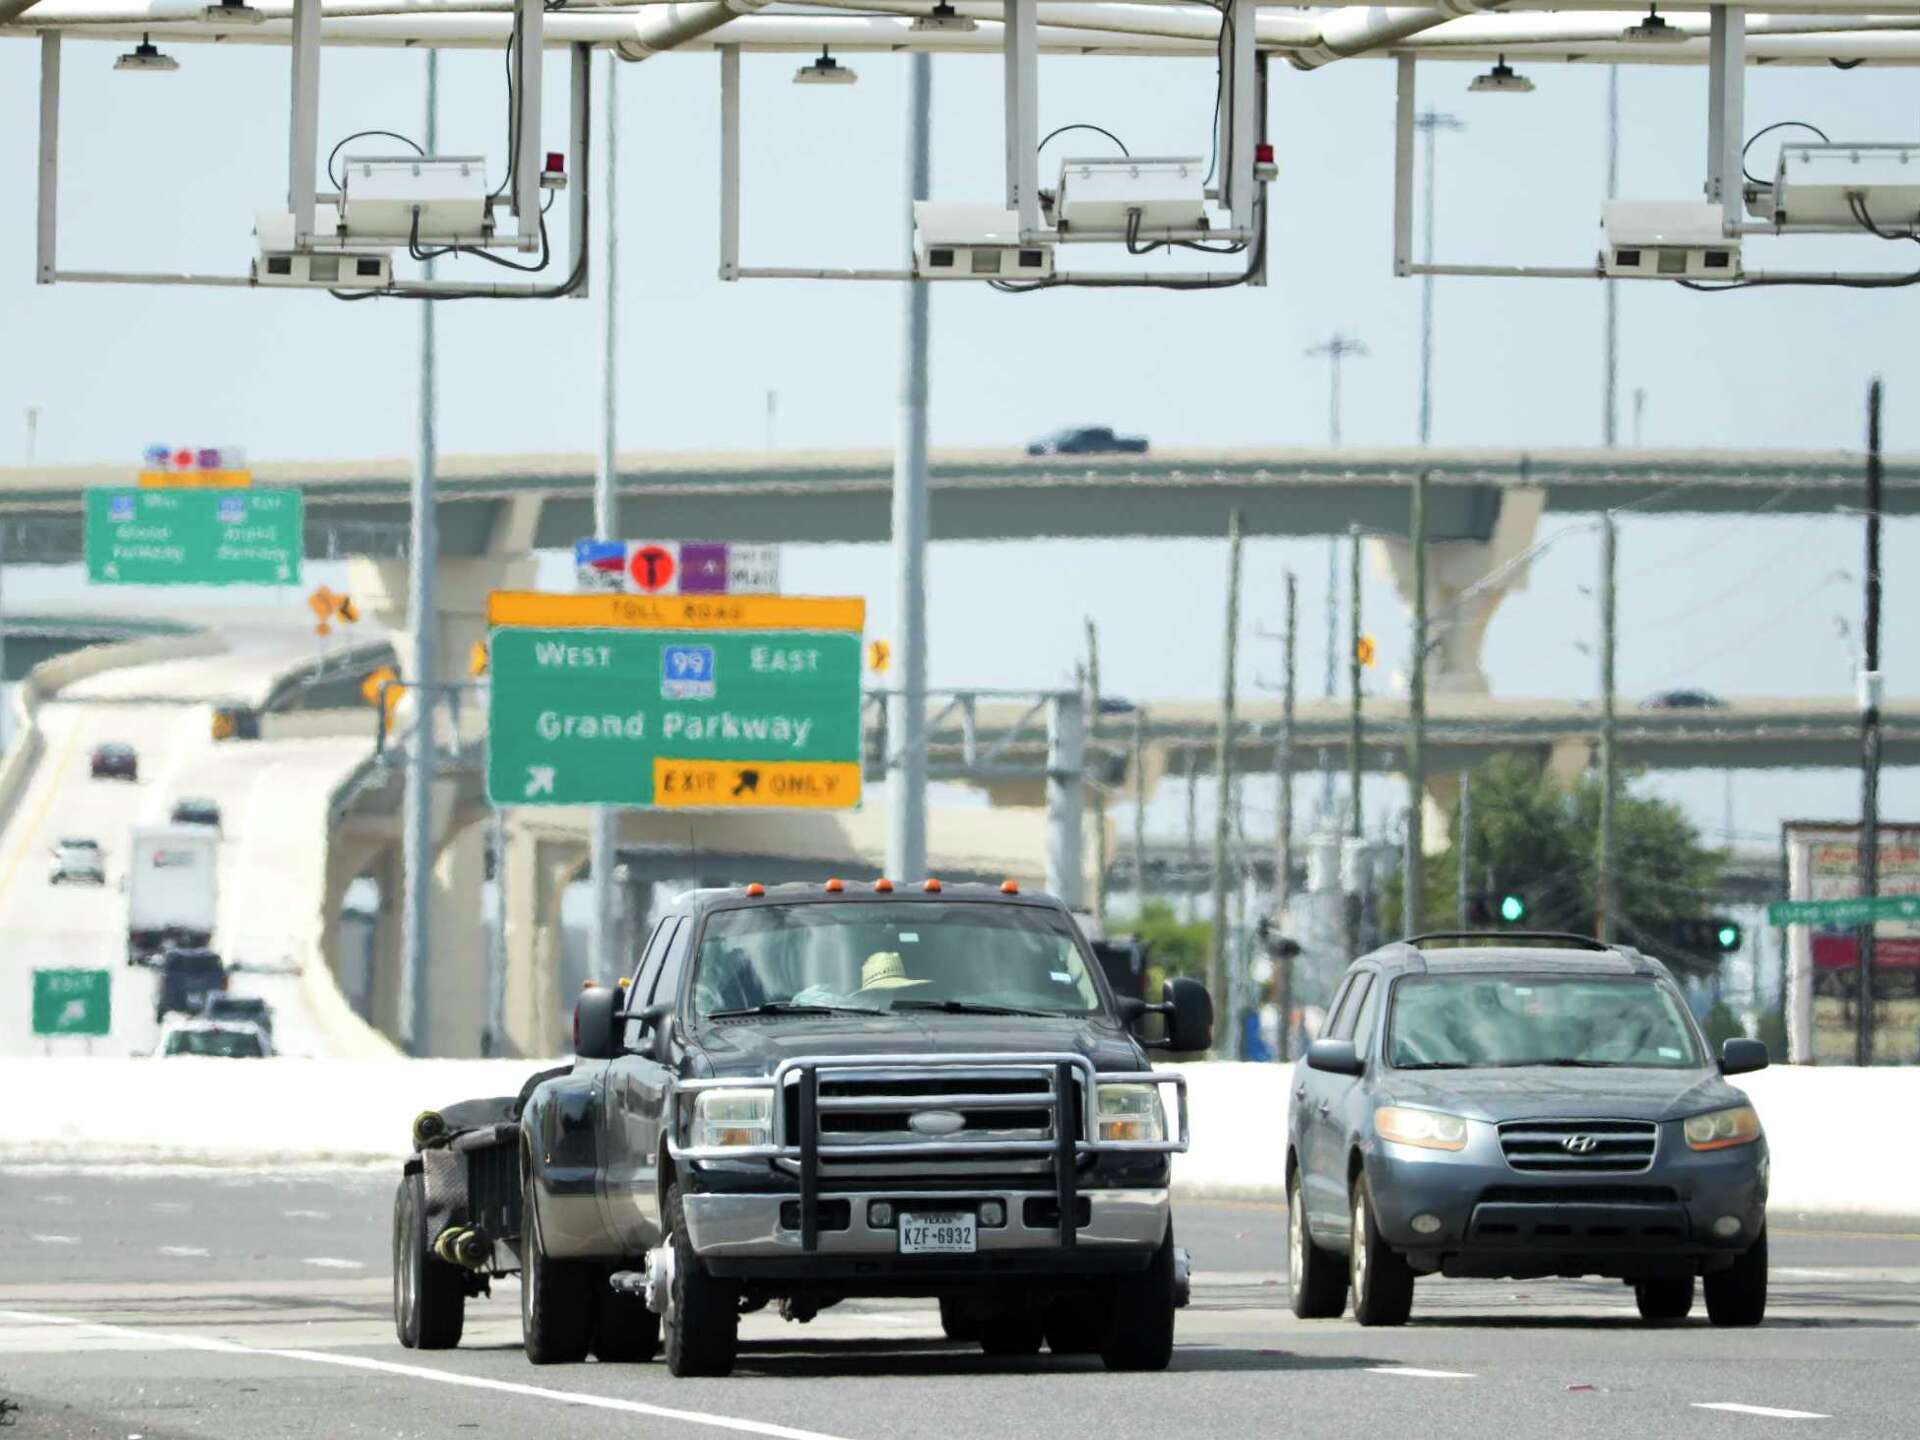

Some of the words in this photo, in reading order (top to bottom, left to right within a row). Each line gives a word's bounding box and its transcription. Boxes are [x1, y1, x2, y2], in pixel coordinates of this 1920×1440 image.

[672, 651, 705, 674] 99
[537, 710, 645, 740] Grand
[661, 711, 812, 749] Parkway
[664, 769, 718, 793] EXIT
[768, 772, 840, 796] ONLY
